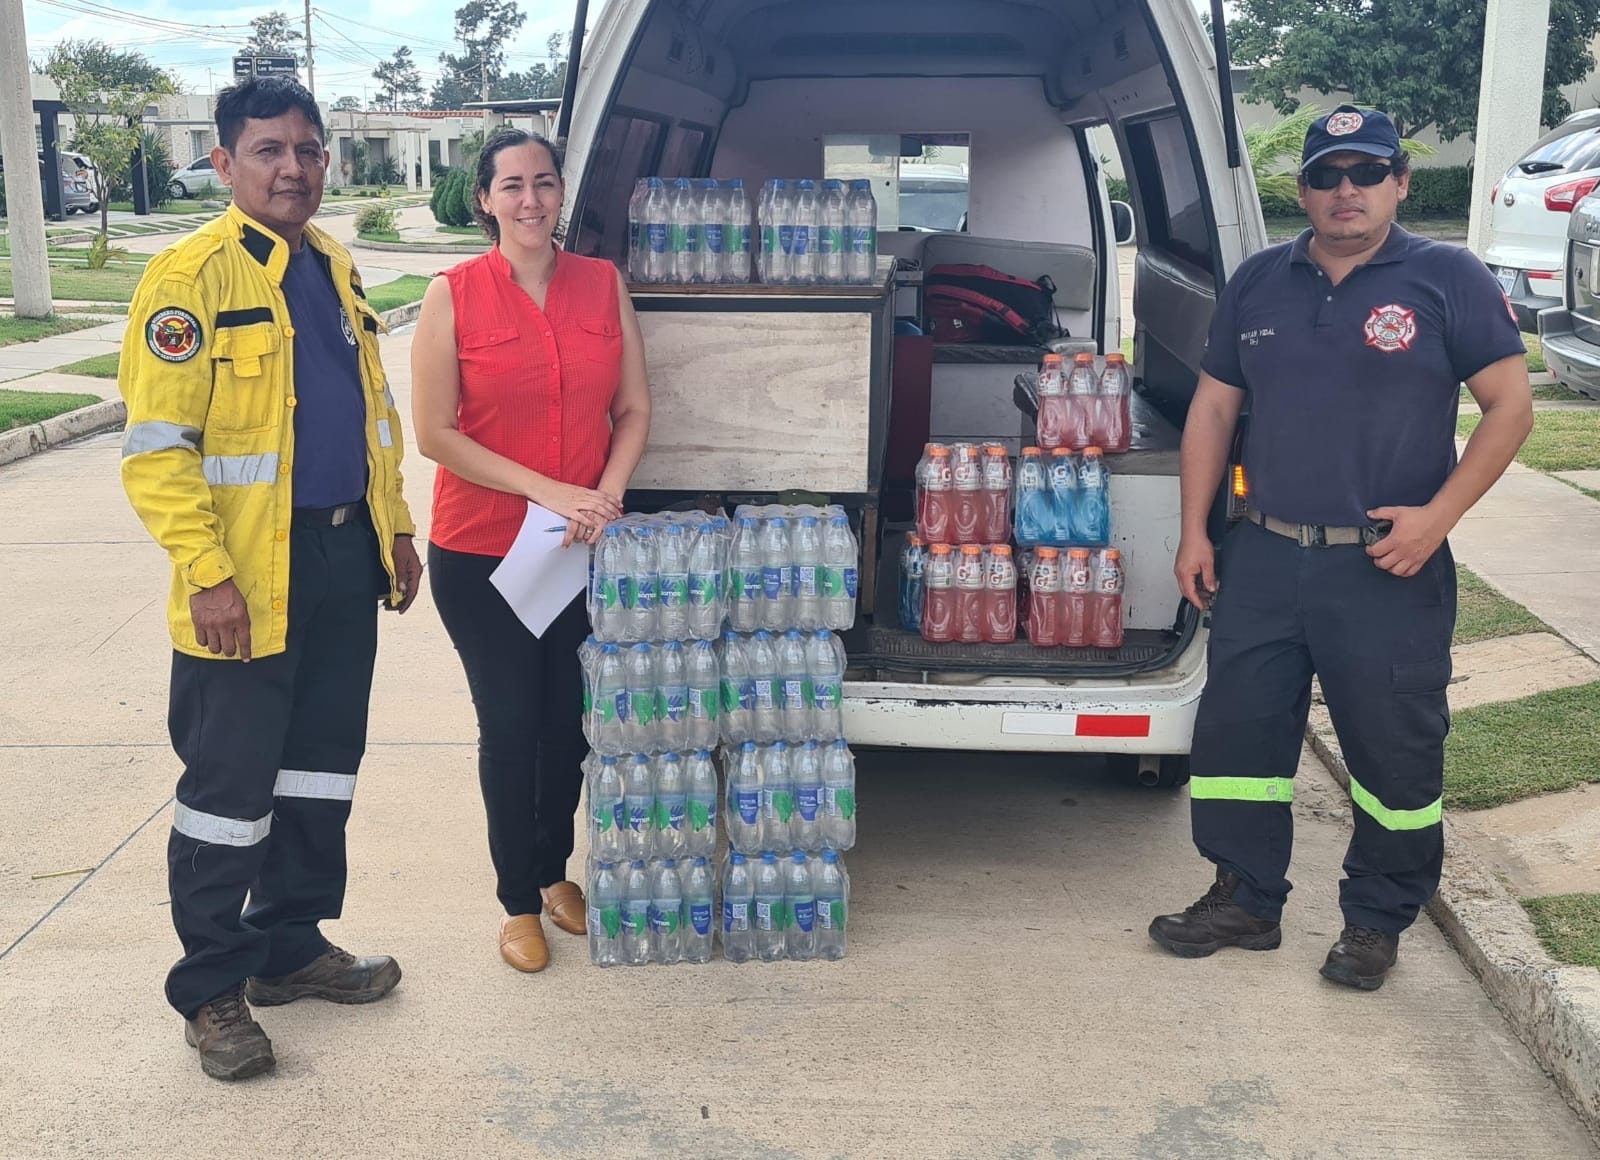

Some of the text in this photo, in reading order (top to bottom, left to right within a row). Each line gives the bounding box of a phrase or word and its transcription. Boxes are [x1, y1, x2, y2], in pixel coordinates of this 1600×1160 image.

[955, 467, 966, 481] G
[1055, 465, 1067, 479] G
[957, 566, 968, 580] G
[991, 574, 1001, 585] G
[1073, 570, 1087, 586] G
[1036, 576, 1047, 587] G
[1104, 579, 1115, 590] G
